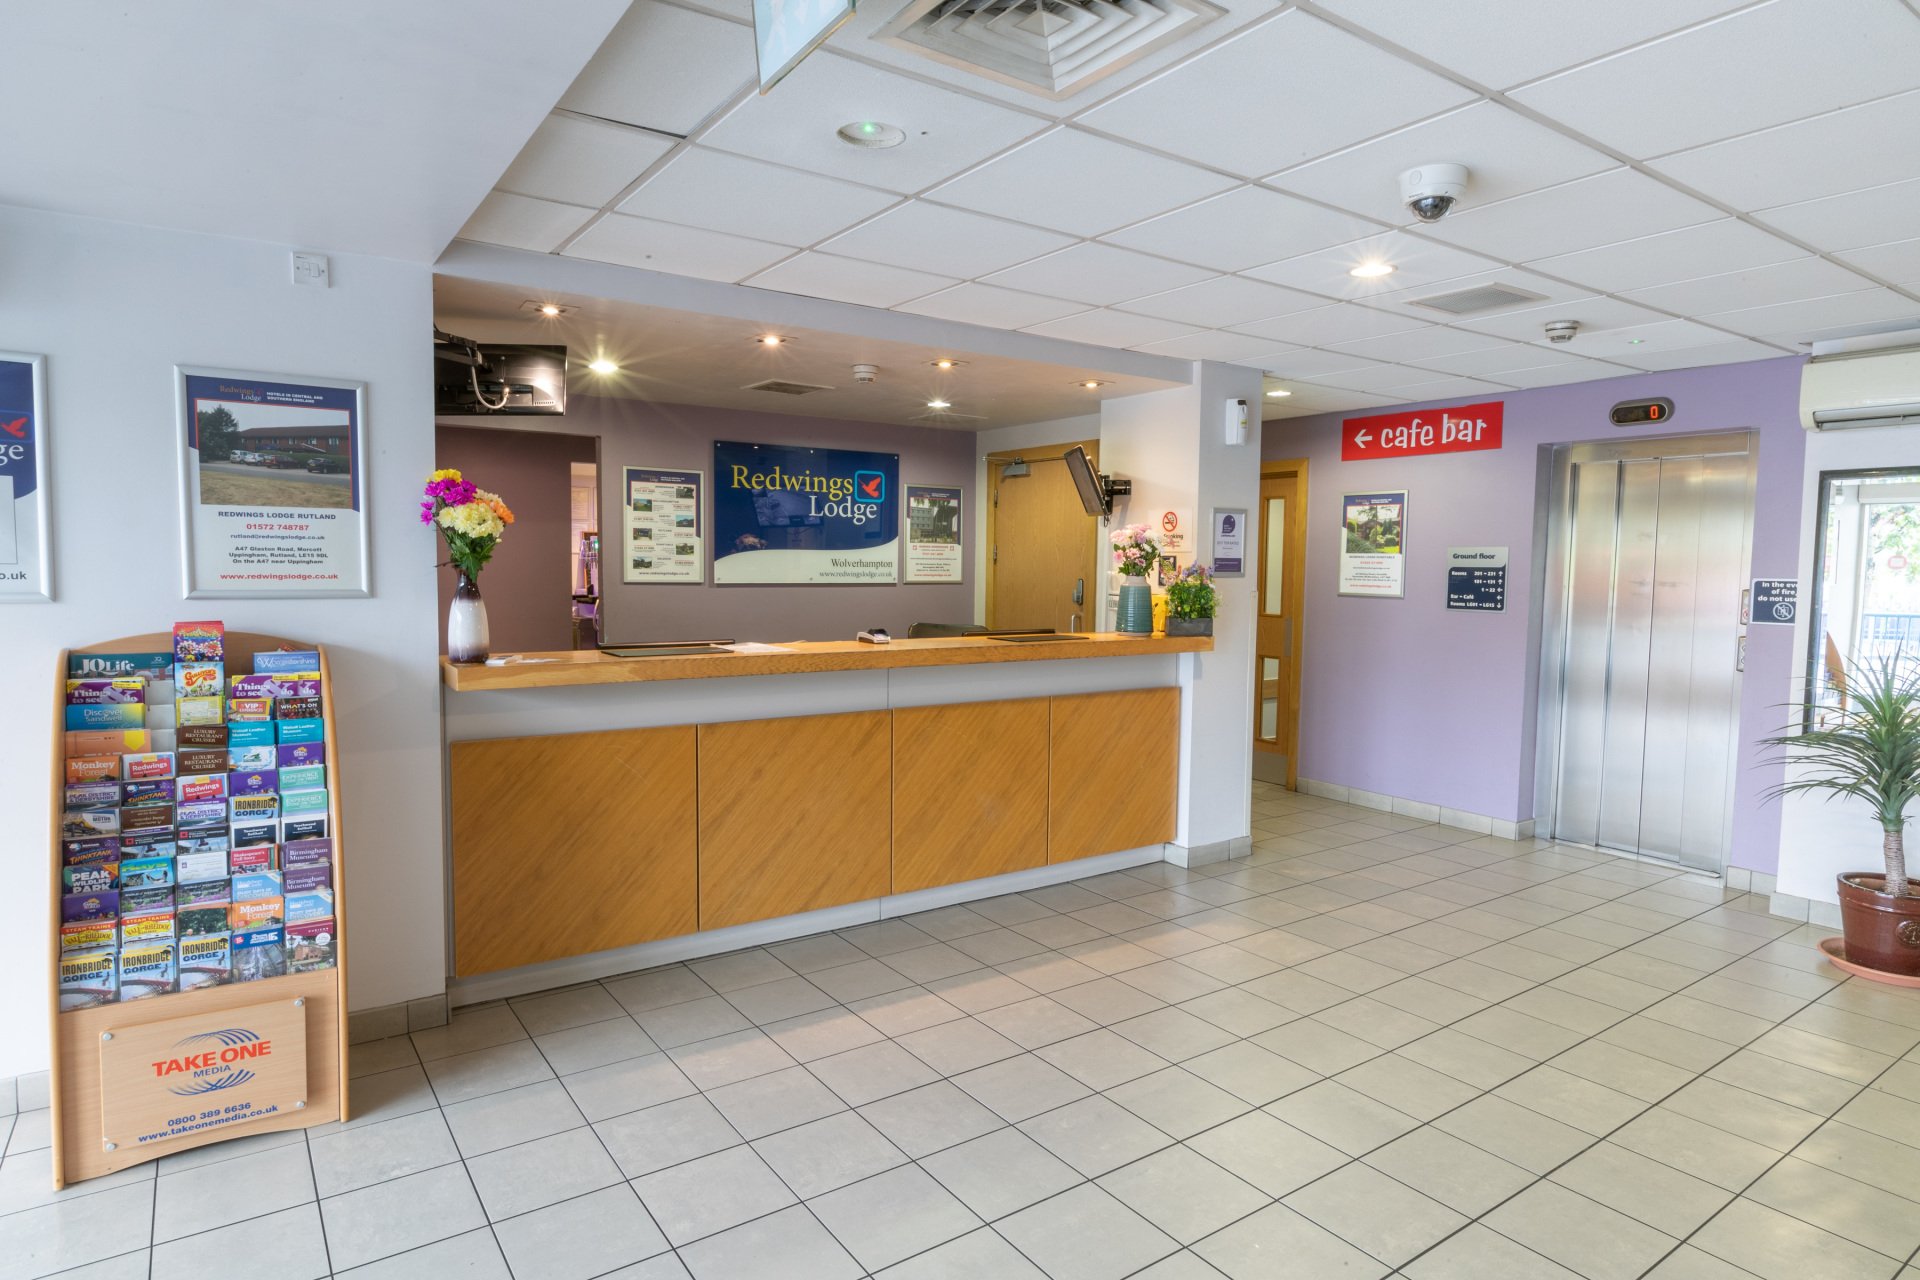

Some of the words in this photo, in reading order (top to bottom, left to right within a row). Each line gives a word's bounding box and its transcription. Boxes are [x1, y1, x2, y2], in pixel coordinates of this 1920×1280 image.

[219, 384, 254, 395] Redwings
[241, 393, 262, 402] Lodge
[1651, 406, 1658, 418] 0
[1381, 418, 1434, 448] cafe
[1442, 414, 1487, 444] bar
[731, 465, 853, 501] Redwings
[809, 496, 877, 525] Lodge
[831, 558, 892, 569] Wolverhampton
[820, 570, 892, 578] www.redwingslodge.co.uk
[105, 660, 134, 670] Life
[236, 683, 270, 691] Things
[73, 689, 111, 697] Things
[124, 695, 138, 703] do
[72, 761, 116, 769] Monkey
[132, 762, 168, 771] Redwings
[186, 783, 219, 793] Redwings
[235, 800, 277, 810] IRONBRIDGE
[70, 850, 112, 864] THINKTANK
[289, 848, 328, 856] Birmingham
[72, 871, 110, 881] PEAK
[286, 876, 325, 884] Birmingham
[73, 878, 111, 887] WILDLIFE
[73, 884, 111, 893] PARK
[240, 904, 280, 913] Monkey
[247, 912, 273, 920] Forest
[182, 941, 227, 955] IRONBRIDGE
[123, 952, 170, 967] IRONBRIDGE
[183, 952, 219, 962] GORGE
[62, 961, 112, 975] IRONBRIDGE
[124, 963, 161, 974] GORGE
[64, 972, 103, 982] GORGE
[152, 1051, 216, 1077] TAKE
[220, 1040, 271, 1063] ONE
[193, 1065, 231, 1078] MEDIA
[167, 1114, 196, 1127] 0800
[200, 1109, 220, 1120] 389
[224, 1102, 251, 1114] 6636
[139, 1105, 278, 1142] www.takeonemedia.co.uk
